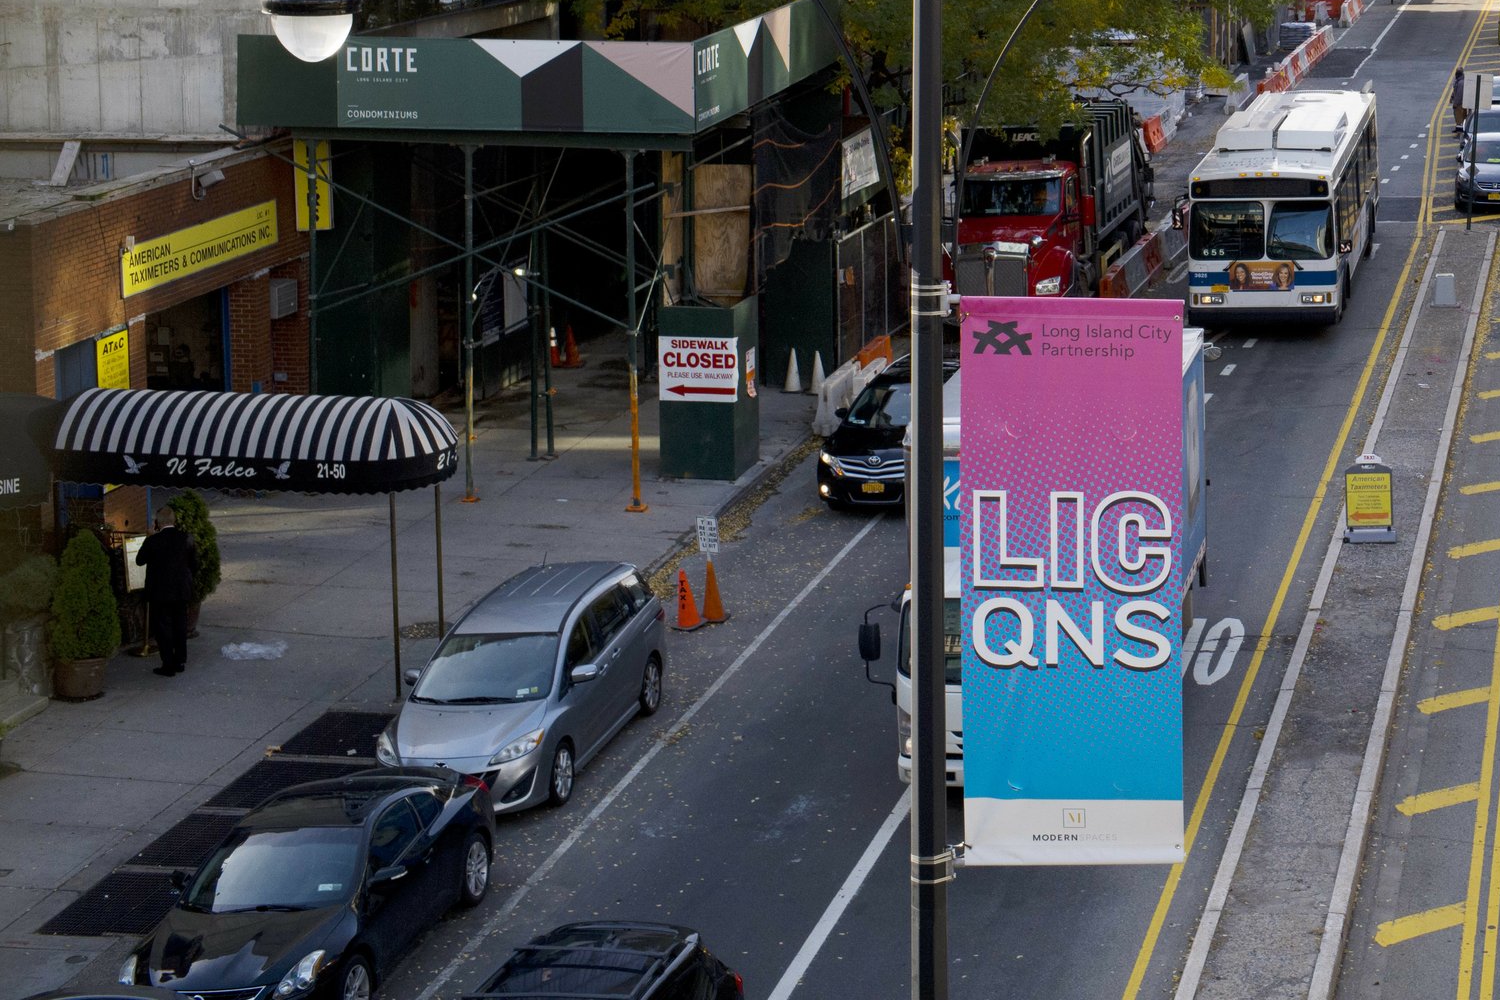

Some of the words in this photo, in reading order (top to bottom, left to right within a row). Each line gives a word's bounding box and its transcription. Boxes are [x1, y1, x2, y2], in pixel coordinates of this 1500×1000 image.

[346, 47, 418, 73] CORTE
[697, 43, 720, 76] CORTE
[347, 109, 418, 119] CONDOMINIUMS
[129, 243, 171, 268] AMERICAN
[130, 254, 180, 285] TAXIMETERS
[182, 256, 188, 269] &
[190, 232, 257, 265] COMMUNICATIONS
[258, 225, 273, 241] INC.
[1041, 324, 1080, 341] Long
[1086, 324, 1133, 339] Island
[1138, 324, 1172, 344] City
[103, 337, 124, 355] AT&C
[671, 339, 728, 350] SIDEWALK
[1041, 342, 1135, 360] Partnership
[663, 351, 736, 369] CLOSED
[667, 371, 689, 379] PLEASE
[691, 371, 702, 379] USE
[704, 372, 733, 380] WALKWAY
[194, 458, 257, 478] Falco
[316, 463, 346, 479] 21-50
[973, 489, 1172, 595] LIC
[972, 597, 1172, 672] QNS
